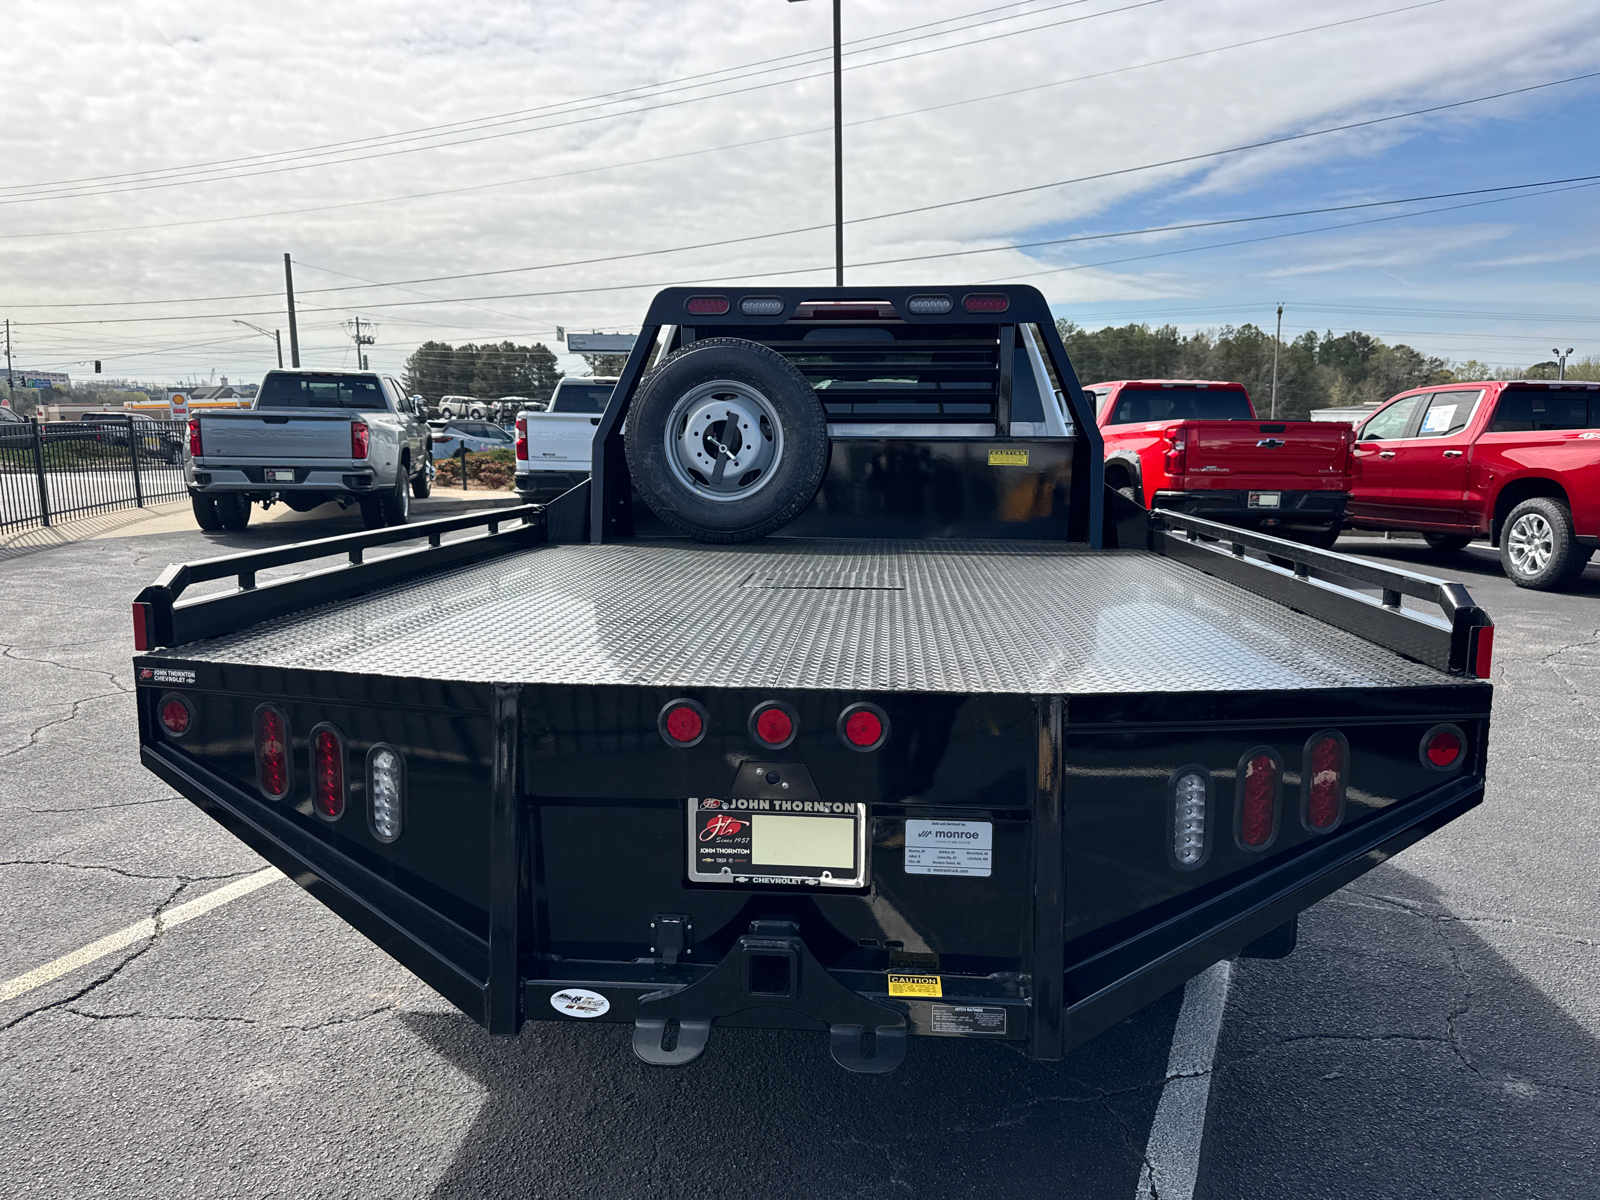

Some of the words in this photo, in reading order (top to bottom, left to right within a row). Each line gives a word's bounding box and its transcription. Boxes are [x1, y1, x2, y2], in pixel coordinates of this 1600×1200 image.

[168, 670, 196, 678] THORNTON
[730, 799, 770, 810] JOHN
[774, 800, 856, 814] THORNTON
[935, 830, 979, 840] monroe
[752, 877, 802, 885] CHEVROLET
